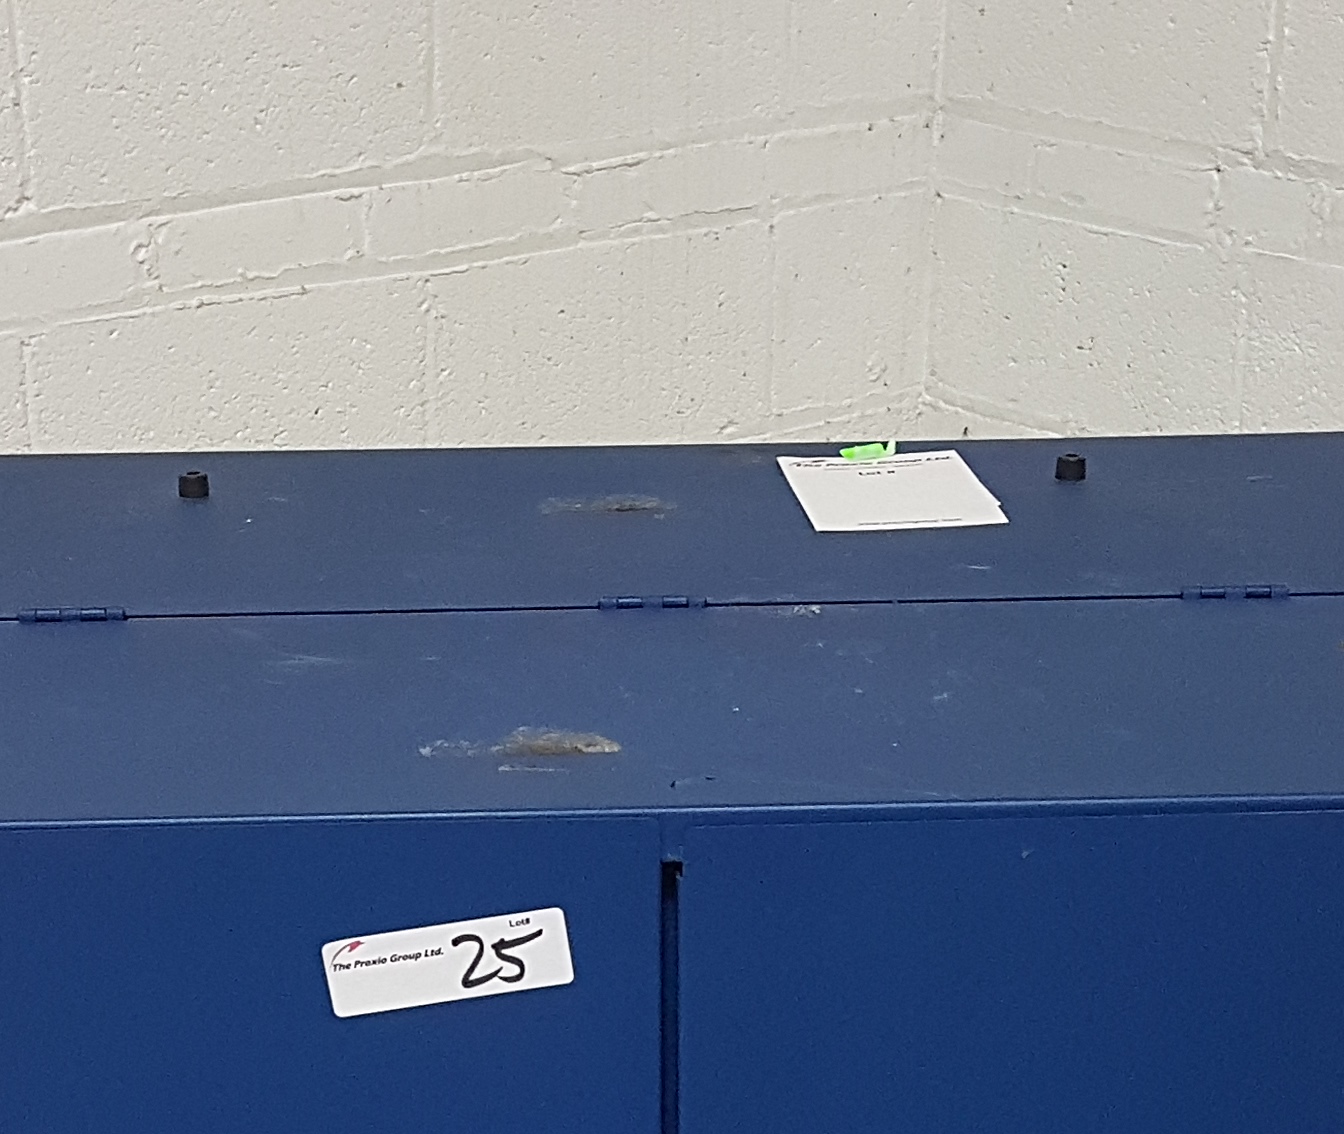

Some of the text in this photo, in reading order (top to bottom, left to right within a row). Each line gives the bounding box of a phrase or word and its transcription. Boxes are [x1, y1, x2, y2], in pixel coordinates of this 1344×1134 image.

[332, 962, 352, 972] The
[389, 951, 423, 963] Group
[424, 947, 444, 958] Ltd.
[452, 928, 544, 989] 25
